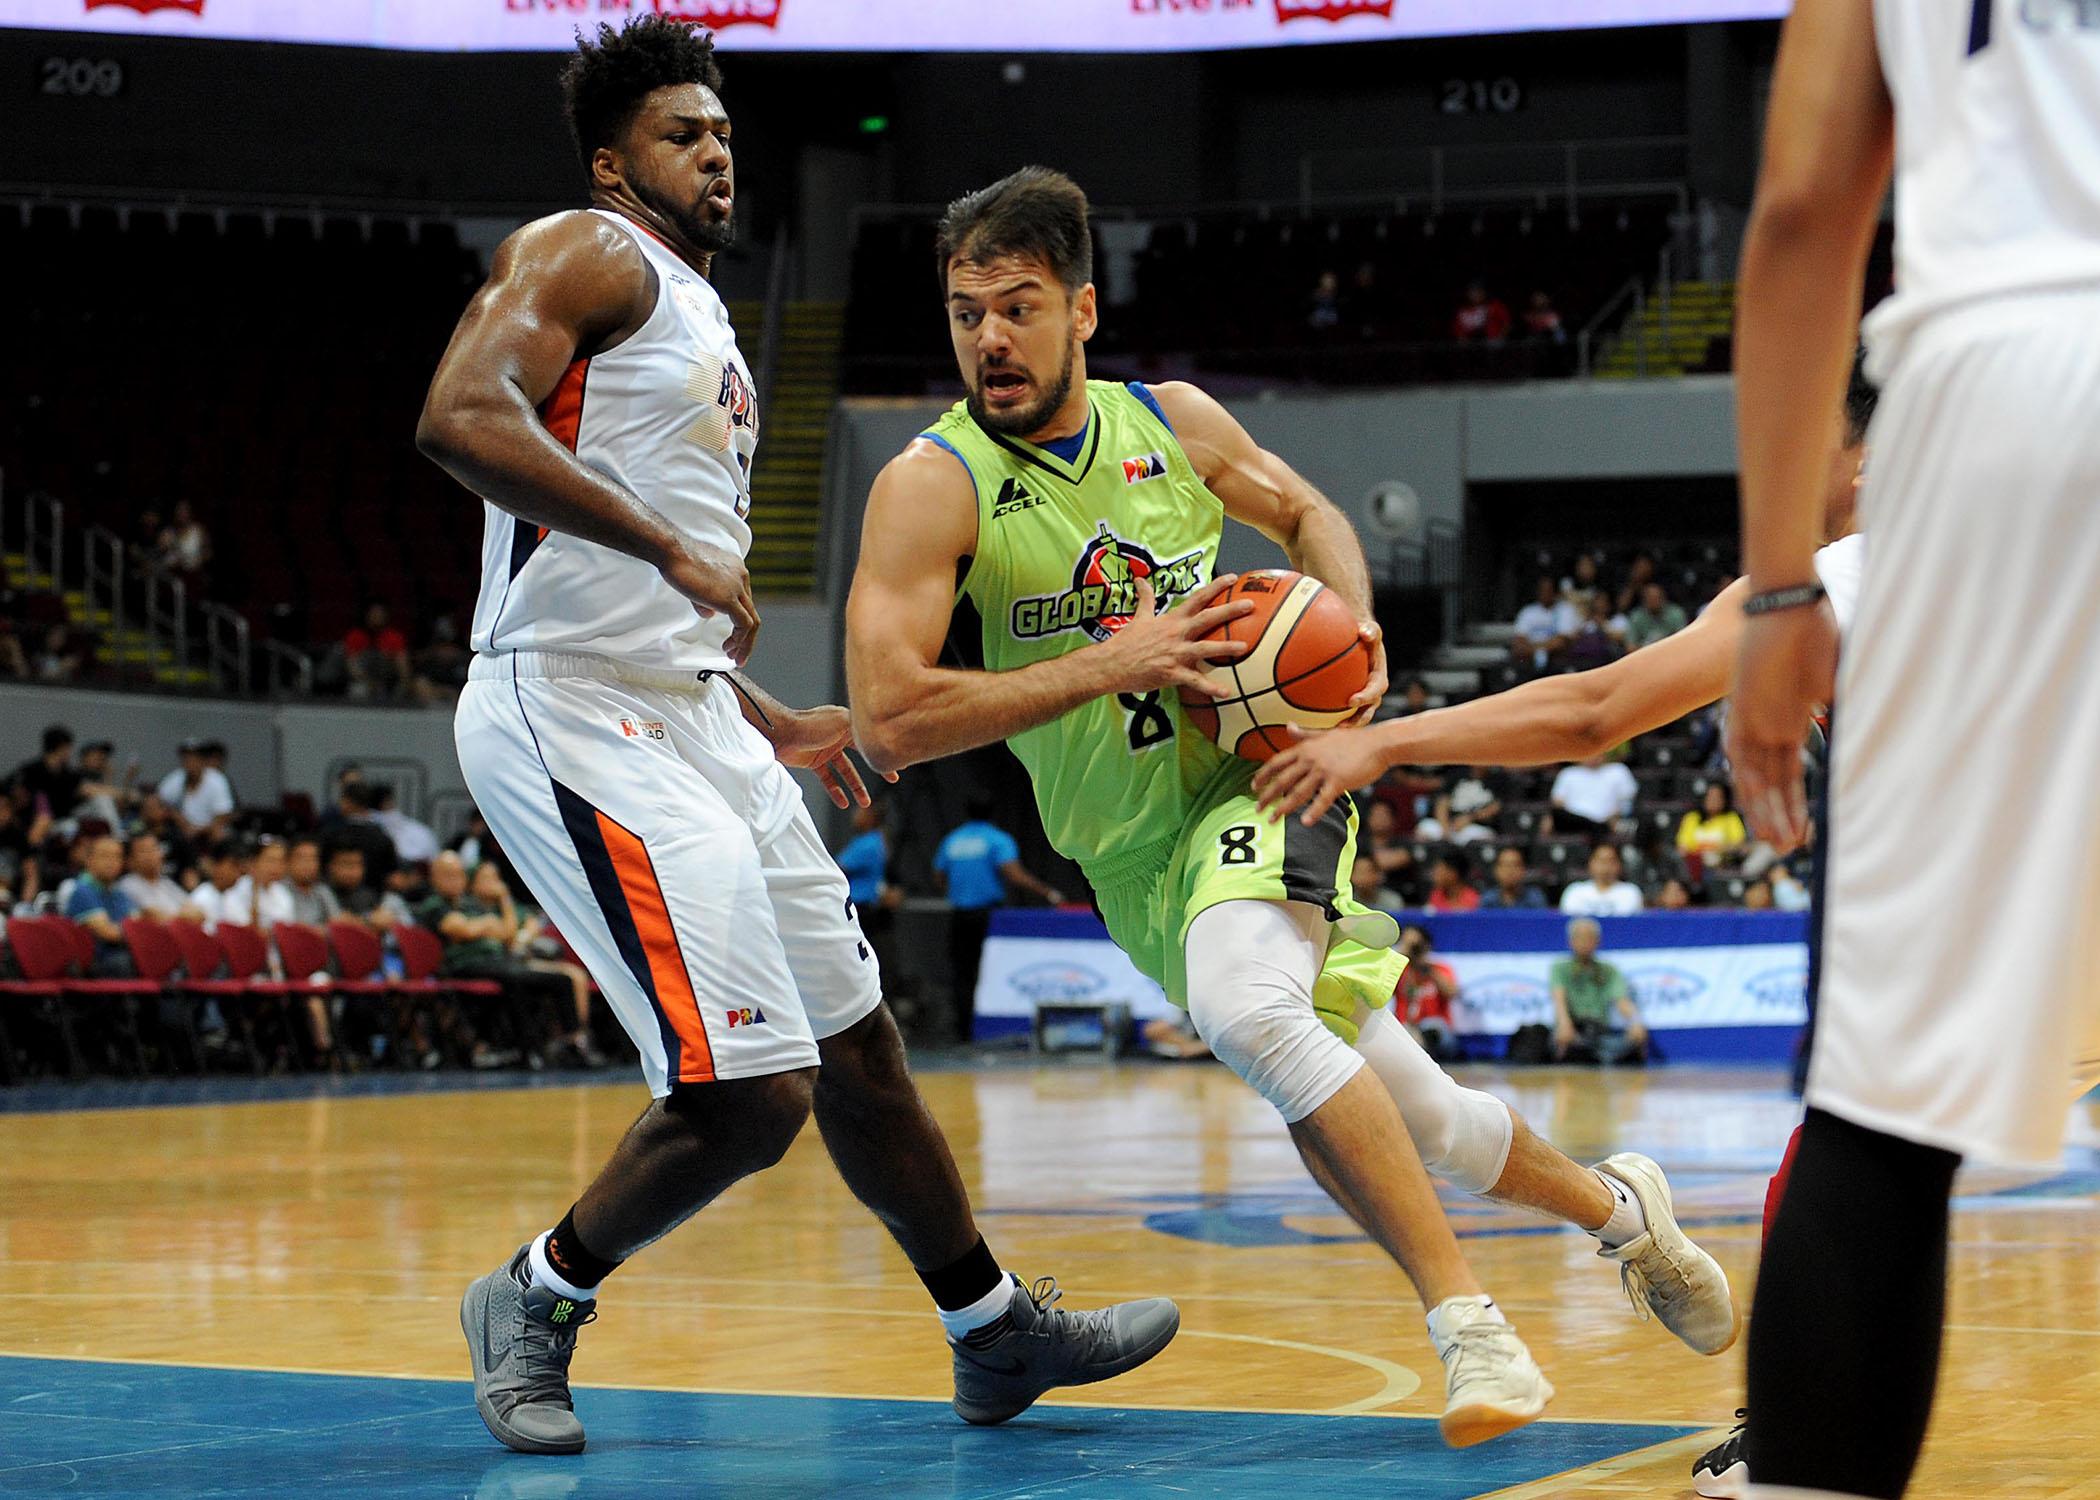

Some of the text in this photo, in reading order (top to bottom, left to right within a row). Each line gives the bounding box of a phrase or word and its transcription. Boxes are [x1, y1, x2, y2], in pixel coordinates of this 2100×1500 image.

[43, 58, 121, 94] 209
[1442, 78, 1519, 112] 210
[1122, 455, 1166, 483] PBA
[1220, 826, 1256, 864] 8
[727, 1008, 767, 1028] PBA
